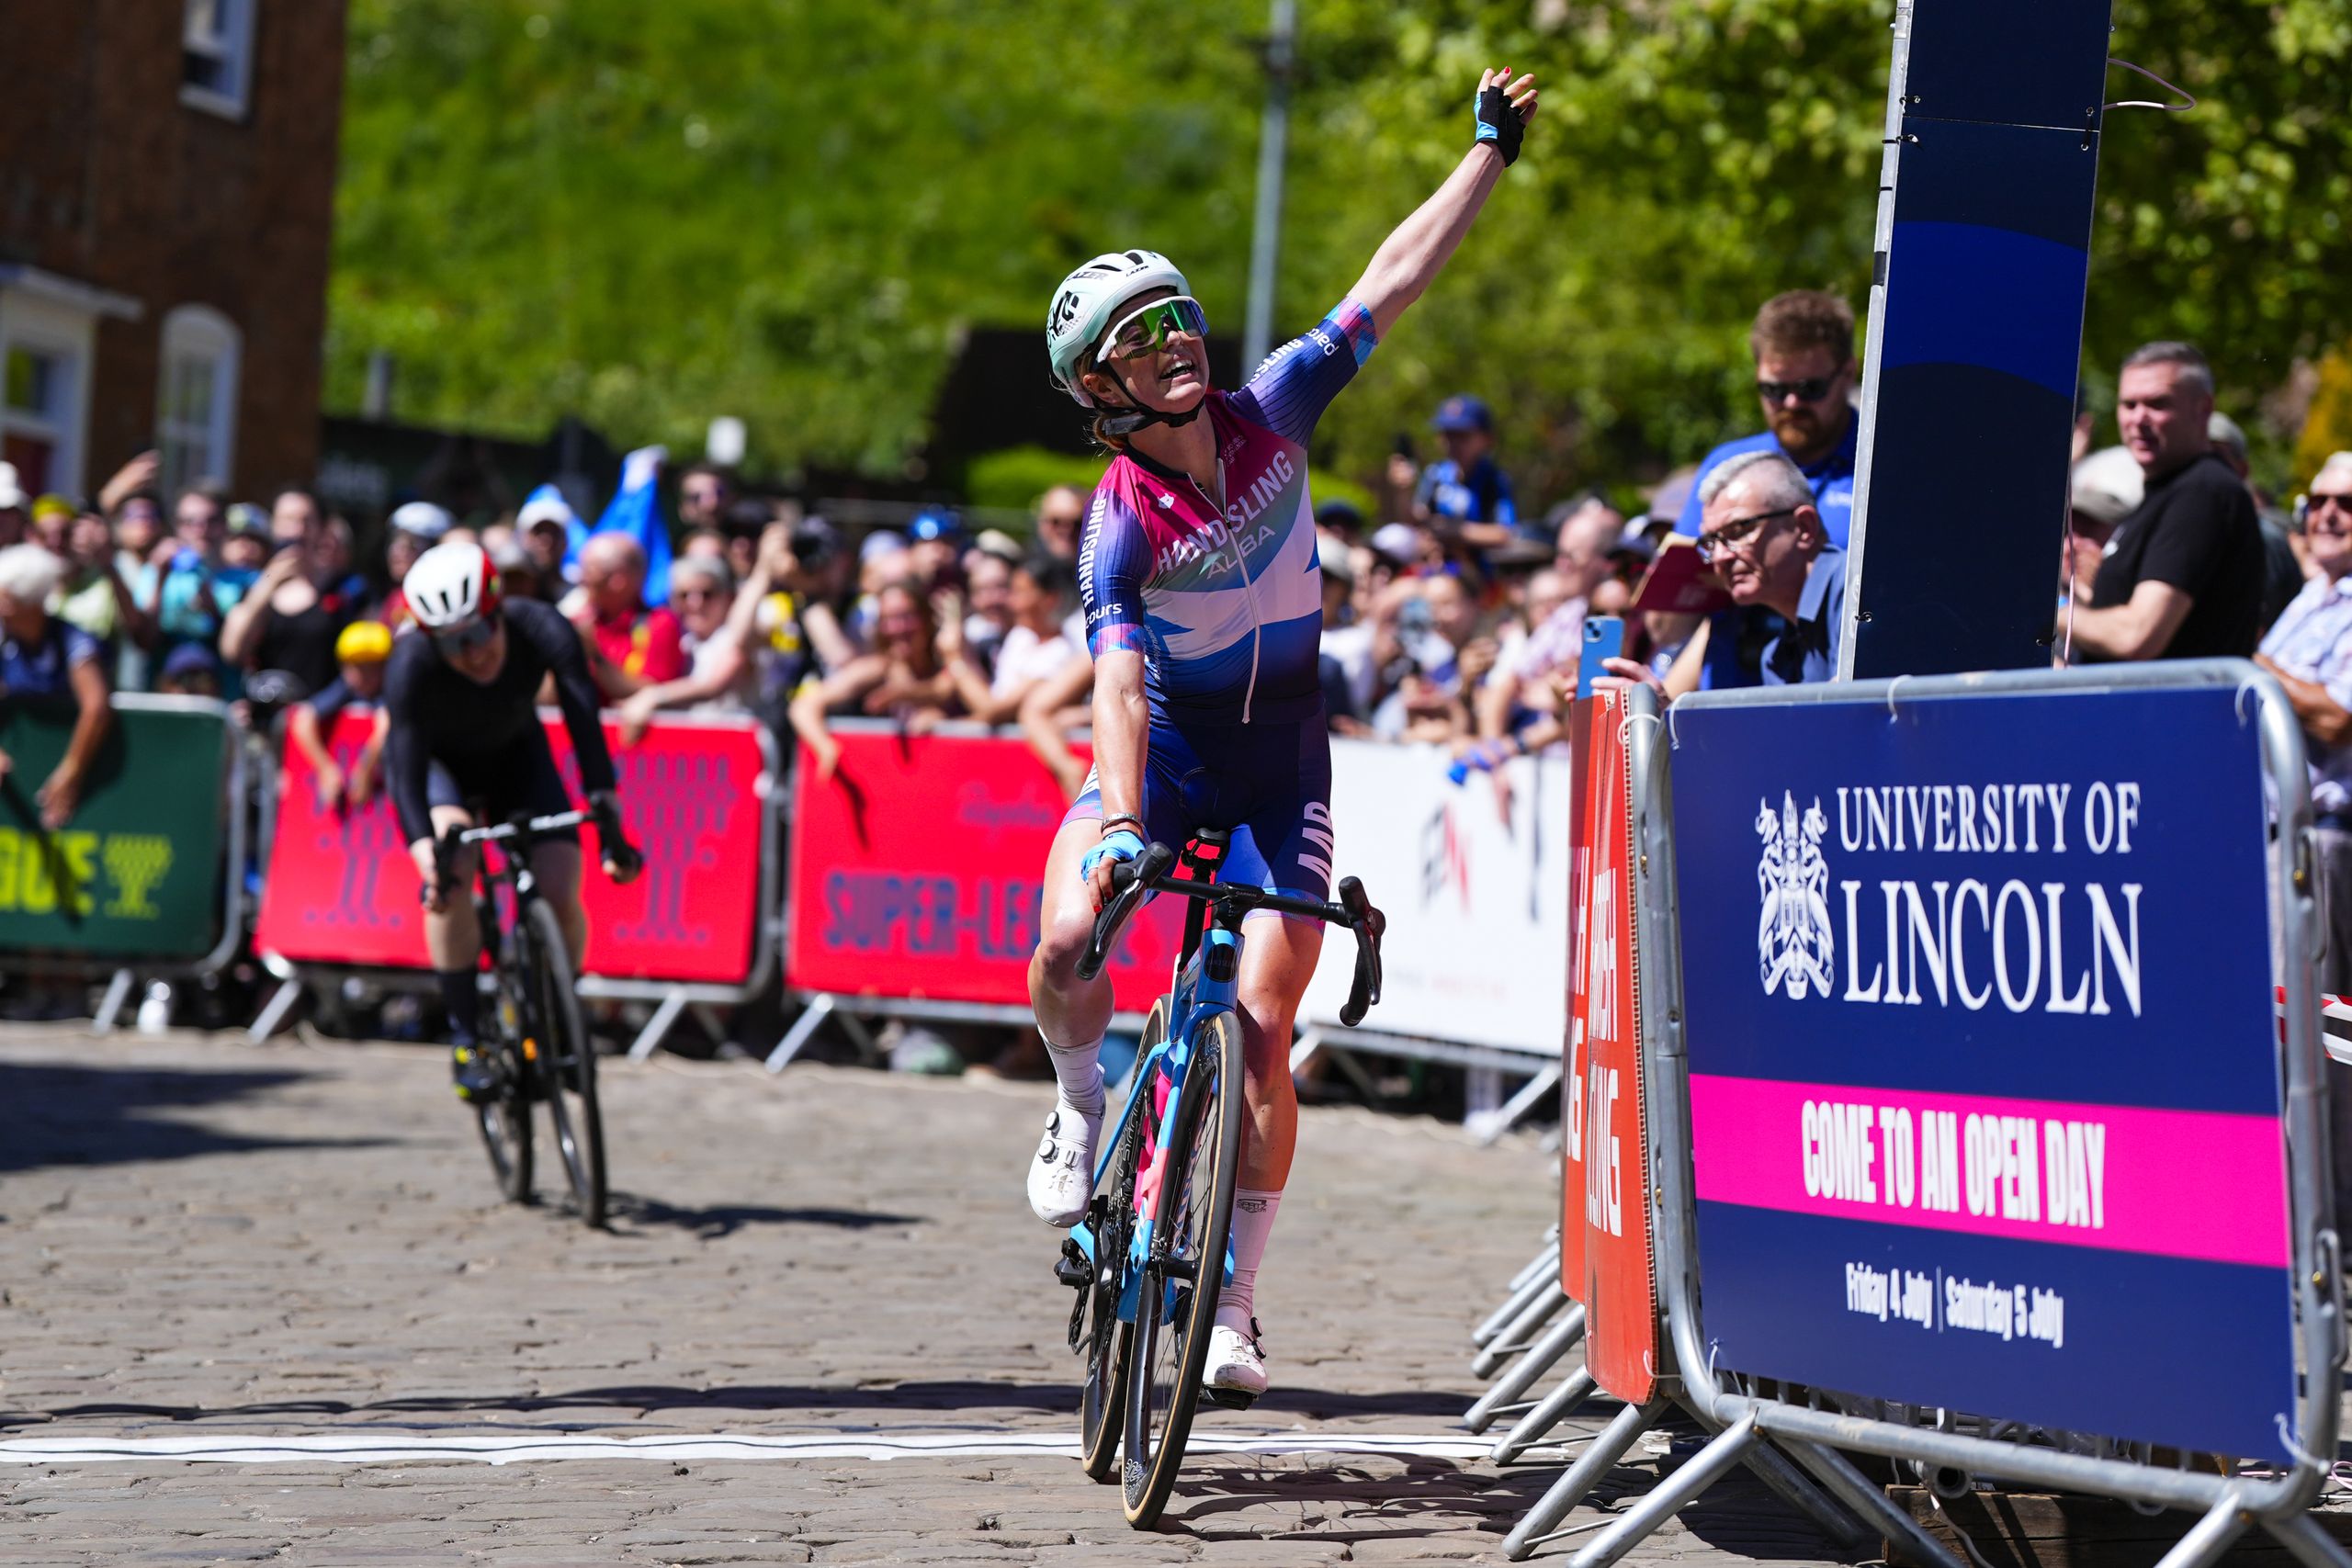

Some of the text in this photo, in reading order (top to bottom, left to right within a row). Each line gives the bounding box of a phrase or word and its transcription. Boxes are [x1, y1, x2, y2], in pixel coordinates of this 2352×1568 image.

[1125, 265, 1149, 277] LAZER
[1079, 498, 1107, 608] HANDSLING
[1158, 450, 1295, 571] HANDSLING
[1206, 525, 1276, 580] ALBA
[1837, 782, 2141, 854] UNIVERSITY OF
[1840, 878, 2143, 1017] LINCOLN
[1801, 1100, 2106, 1229] COME TO AN OPEN DAY
[1845, 1261, 2064, 1348] Friday 4 July Saturday 5 July
